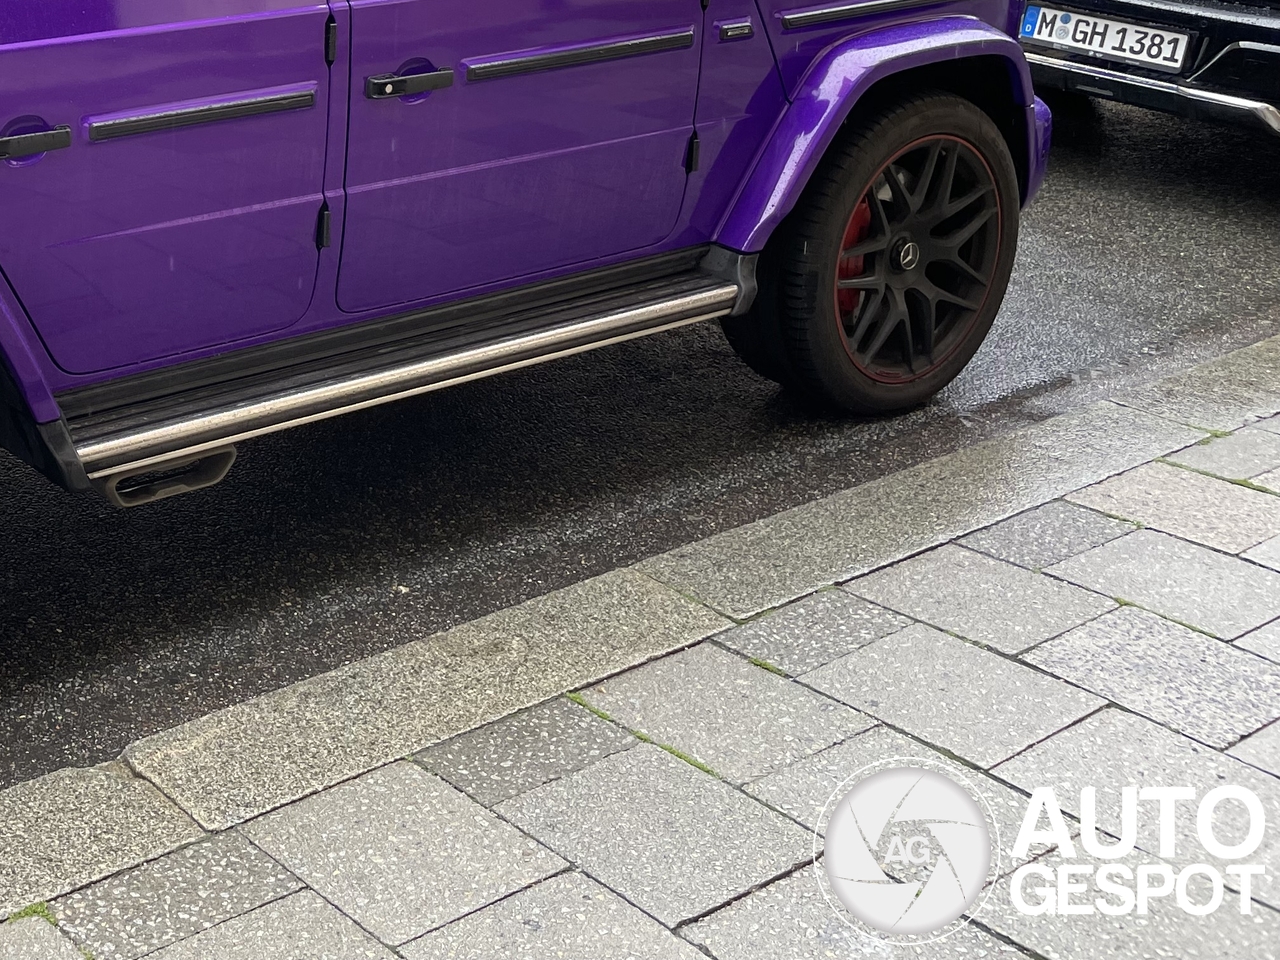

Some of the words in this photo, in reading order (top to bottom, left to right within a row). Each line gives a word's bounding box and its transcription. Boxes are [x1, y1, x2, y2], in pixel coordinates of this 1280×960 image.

[1025, 24, 1032, 33] D
[1037, 11, 1058, 38] M
[1071, 18, 1110, 48] GH
[1111, 27, 1181, 64] 1381
